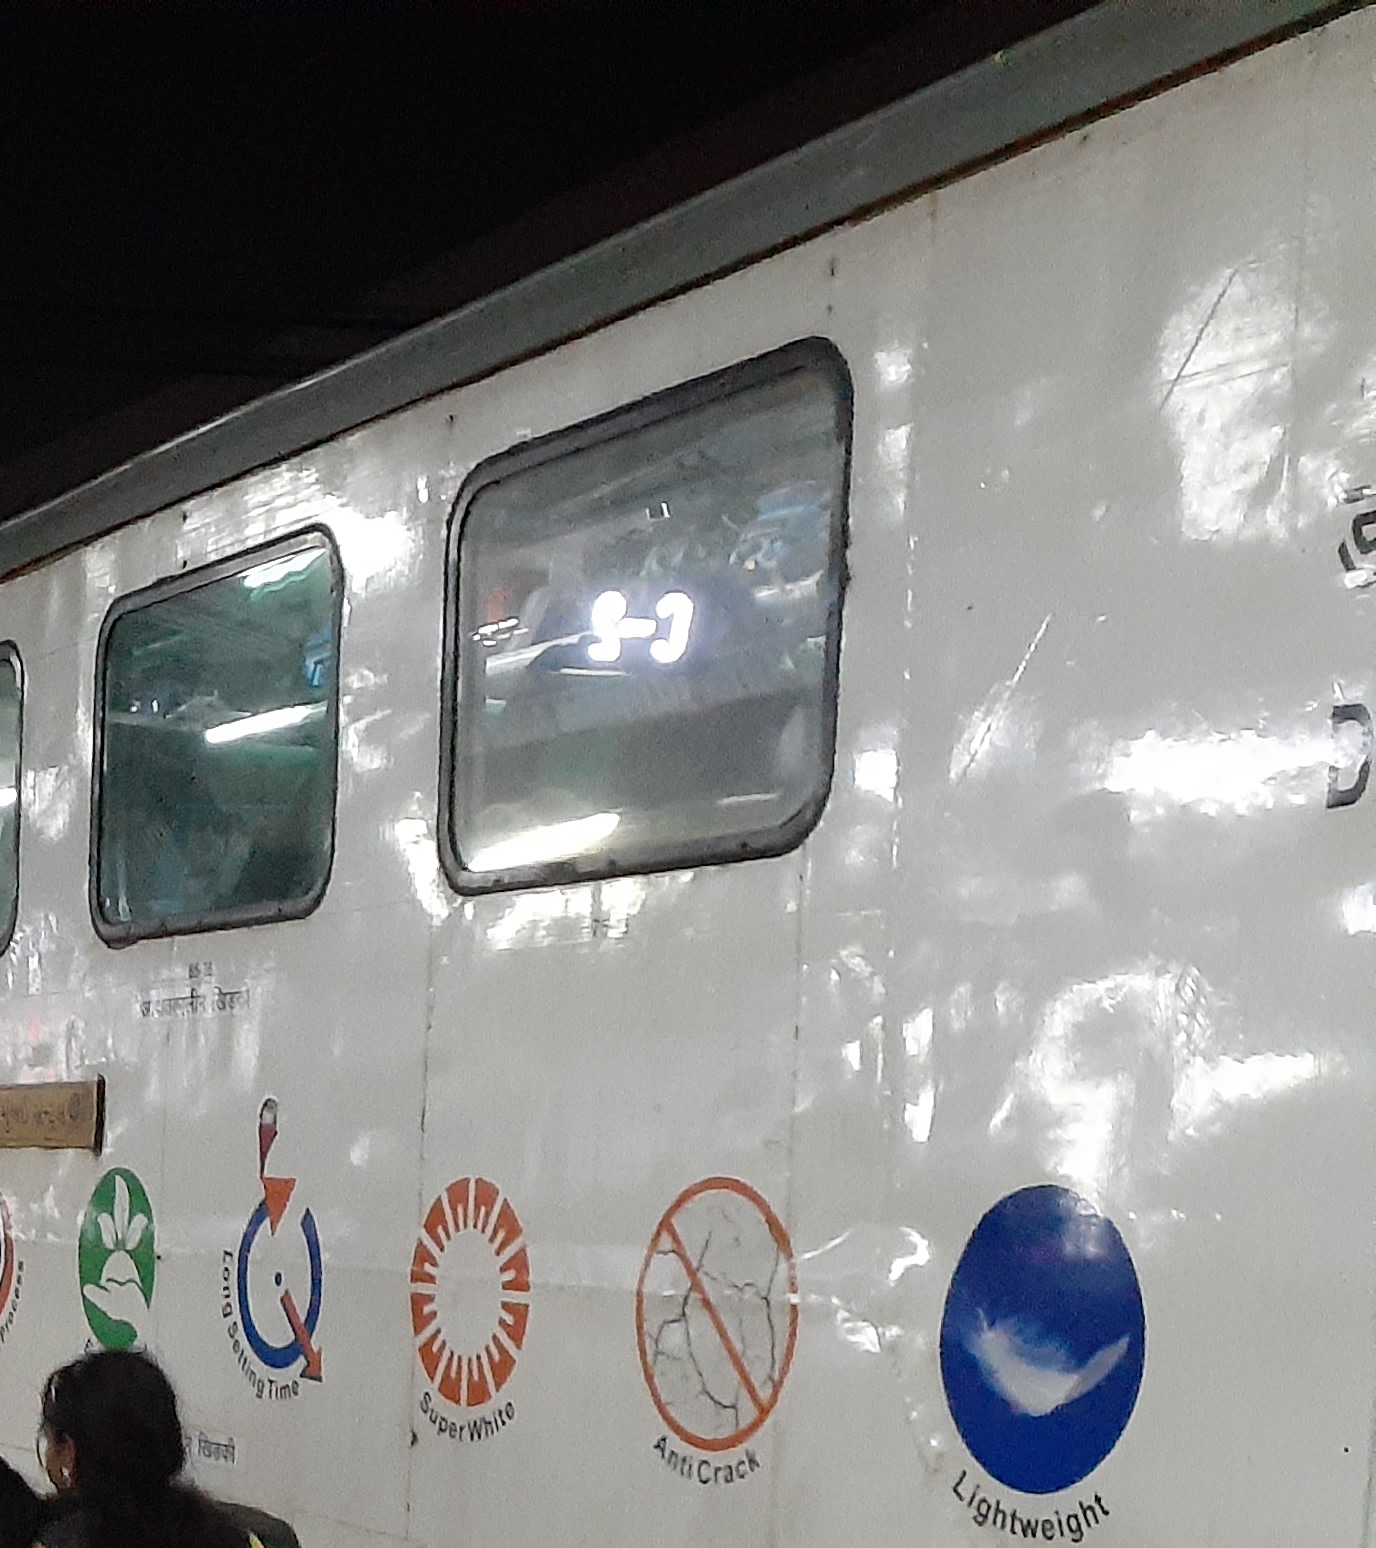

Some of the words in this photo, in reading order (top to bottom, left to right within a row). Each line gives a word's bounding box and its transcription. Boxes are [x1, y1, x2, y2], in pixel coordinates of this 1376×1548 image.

[0, 1260, 25, 1345] Process
[221, 1250, 234, 1319] Long
[227, 1321, 266, 1400] Setting
[266, 1377, 300, 1401] Time
[419, 1391, 466, 1442] Super
[467, 1401, 515, 1442] White
[652, 1435, 693, 1480] Anti
[697, 1448, 761, 1485] Crack
[951, 1468, 1111, 1544] Lightweight
